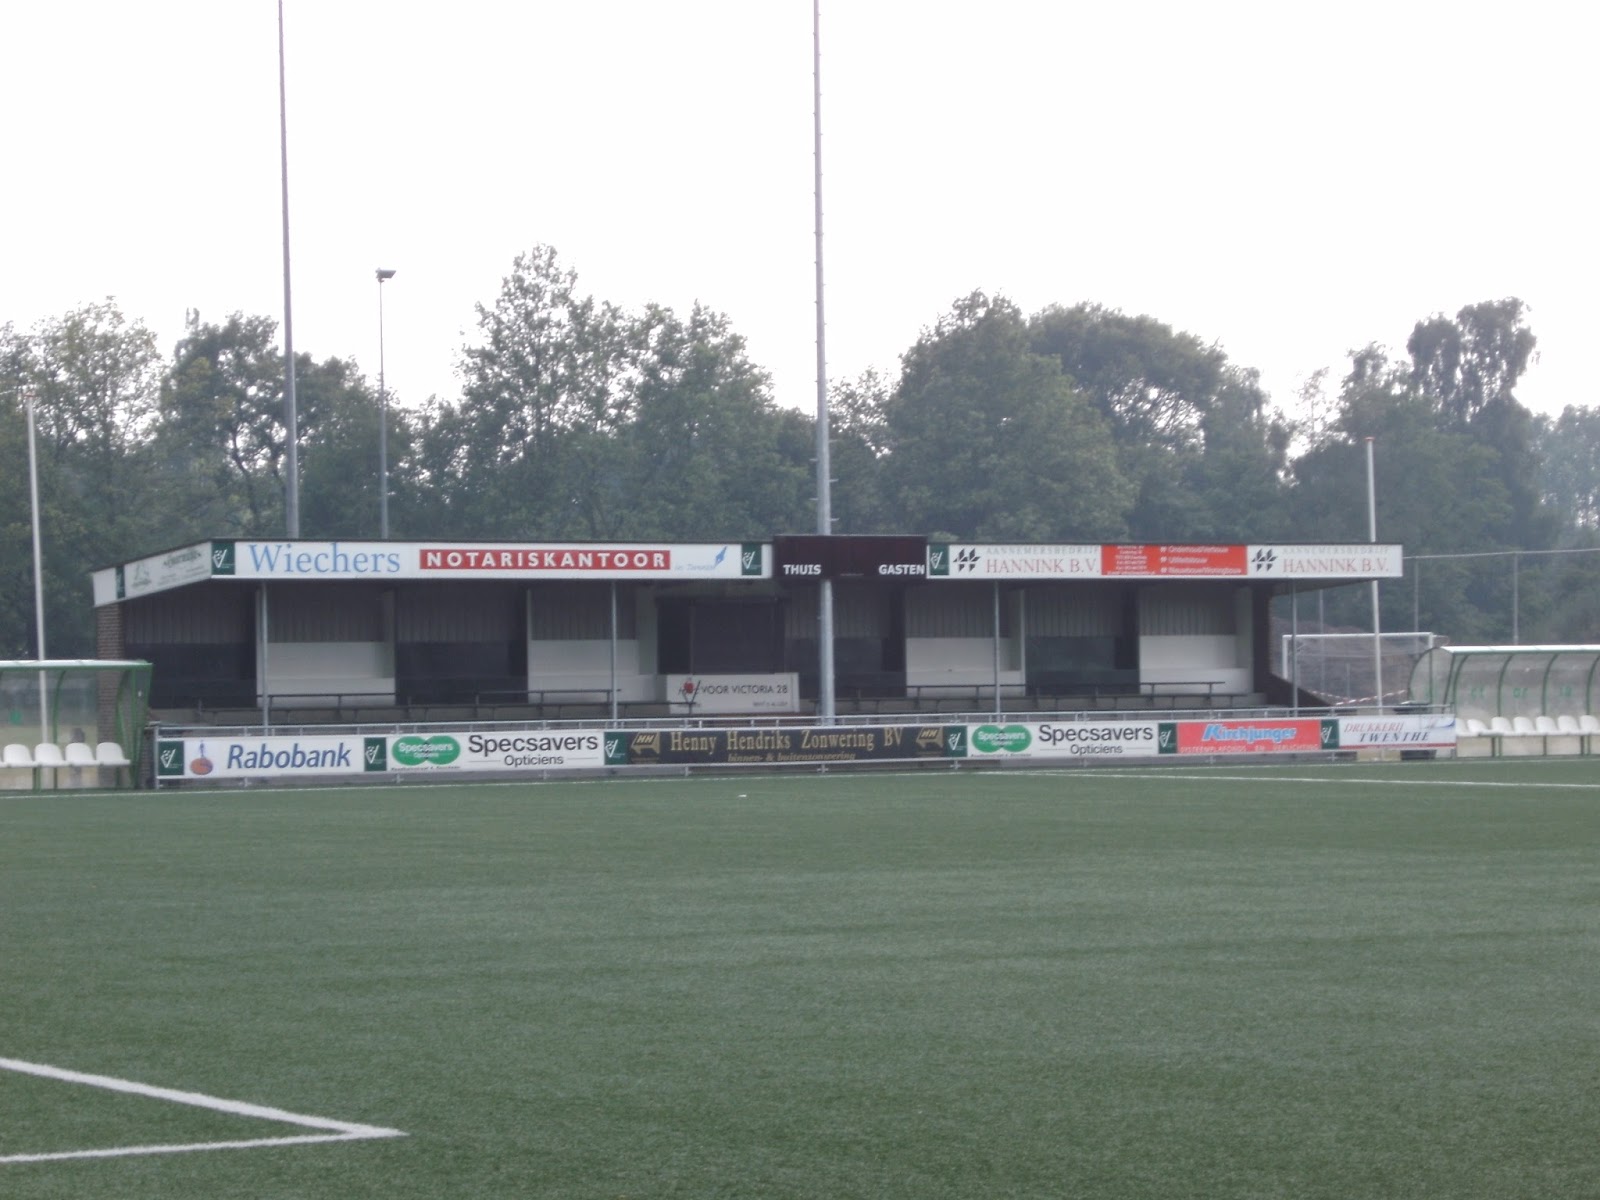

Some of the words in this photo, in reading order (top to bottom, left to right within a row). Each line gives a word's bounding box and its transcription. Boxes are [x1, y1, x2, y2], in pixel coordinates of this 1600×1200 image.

[249, 542, 400, 573] Wiechers
[427, 552, 666, 568] NOTARISKANTOOR
[783, 564, 822, 576] THUIS
[879, 564, 925, 576] GASTEN
[986, 559, 1065, 574] HANNINK
[1070, 559, 1100, 574] B.V.
[1282, 558, 1357, 573] HANNINK
[1361, 558, 1390, 573] B.V.
[701, 685, 728, 695] VOOR
[731, 685, 773, 694] VICTORIA
[776, 684, 788, 694] 28
[670, 731, 717, 755] Henny
[727, 729, 792, 750] Hendriks
[801, 728, 875, 751] Zonwering
[883, 727, 904, 747] BV
[1038, 724, 1154, 746] Specsavers
[1201, 723, 1297, 744] Kirchjunger
[1359, 731, 1430, 743] TWENTHE
[468, 732, 599, 755] Specsavers
[1070, 743, 1123, 755] Opticiens
[227, 743, 351, 769] Rabobank
[503, 754, 564, 767] Opticiens
